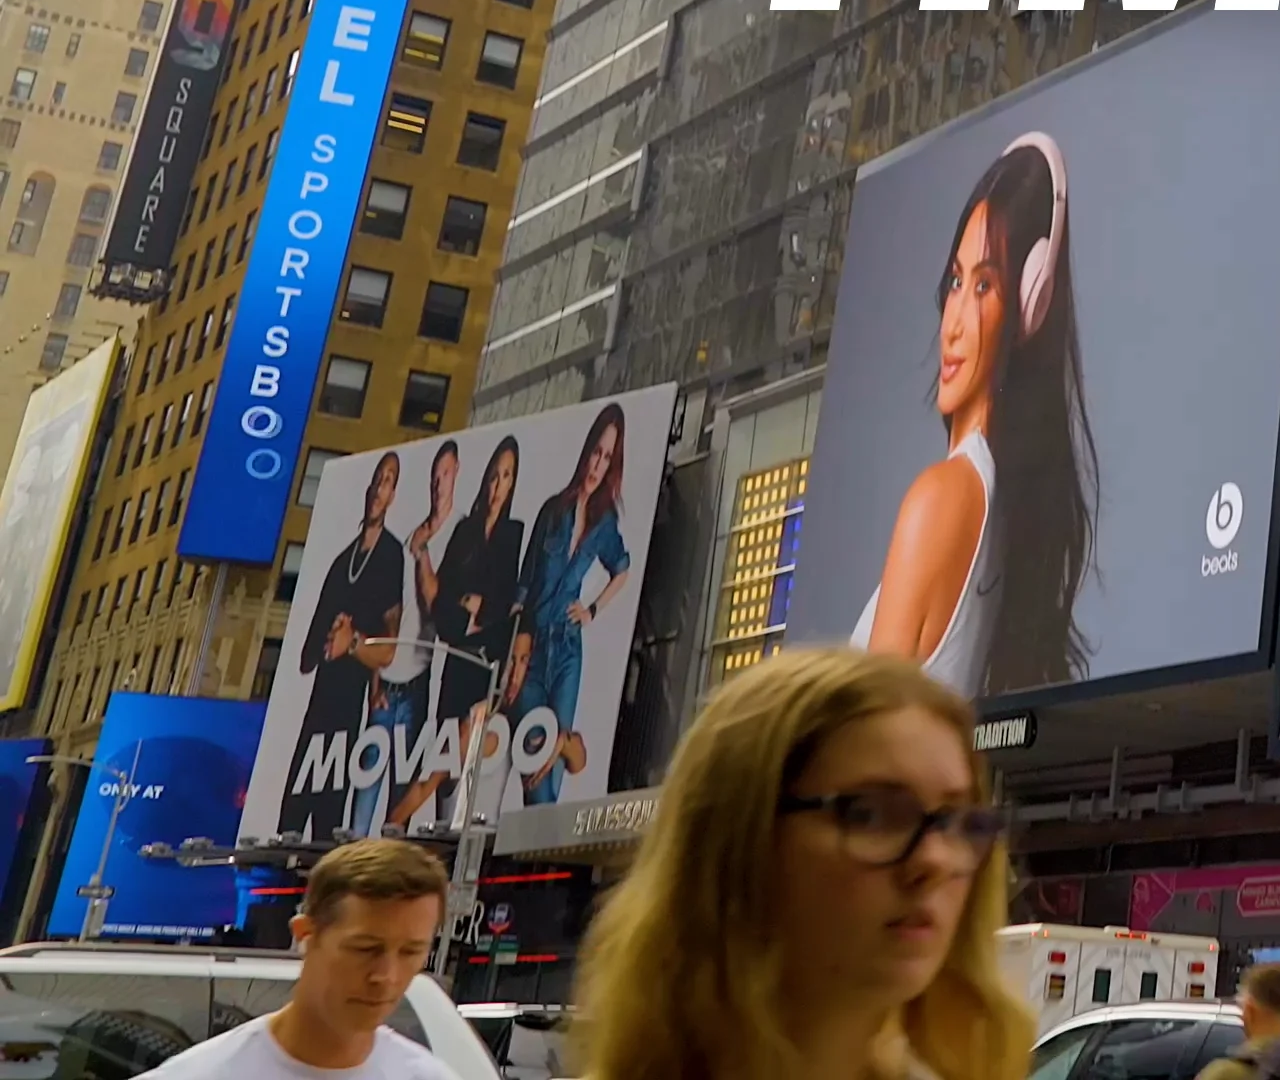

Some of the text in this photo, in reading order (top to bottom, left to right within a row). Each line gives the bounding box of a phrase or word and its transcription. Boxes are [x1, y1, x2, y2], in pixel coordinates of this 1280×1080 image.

[134, 78, 191, 253] SQUARE
[1201, 548, 1238, 577] beats
[292, 706, 558, 795] MOVADO
[99, 783, 164, 799] ONY AT
